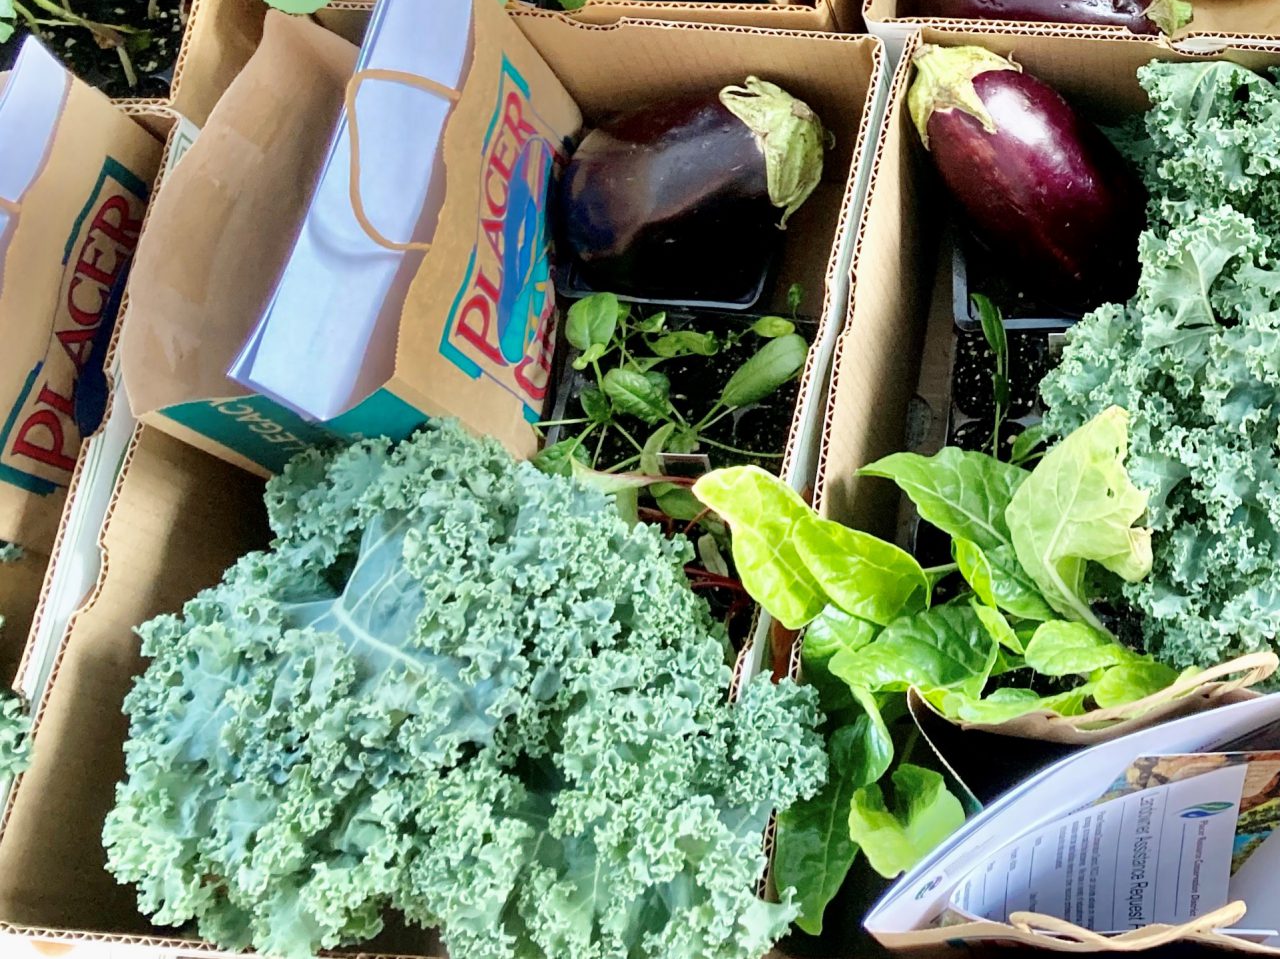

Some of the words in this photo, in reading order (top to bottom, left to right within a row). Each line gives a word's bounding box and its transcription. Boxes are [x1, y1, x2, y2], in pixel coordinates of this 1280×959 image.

[455, 90, 540, 368] PLACER
[10, 194, 147, 472] PLACER
[1136, 791, 1160, 839] Landowner
[1131, 836, 1154, 881] Assistance
[1126, 881, 1149, 922] Request
